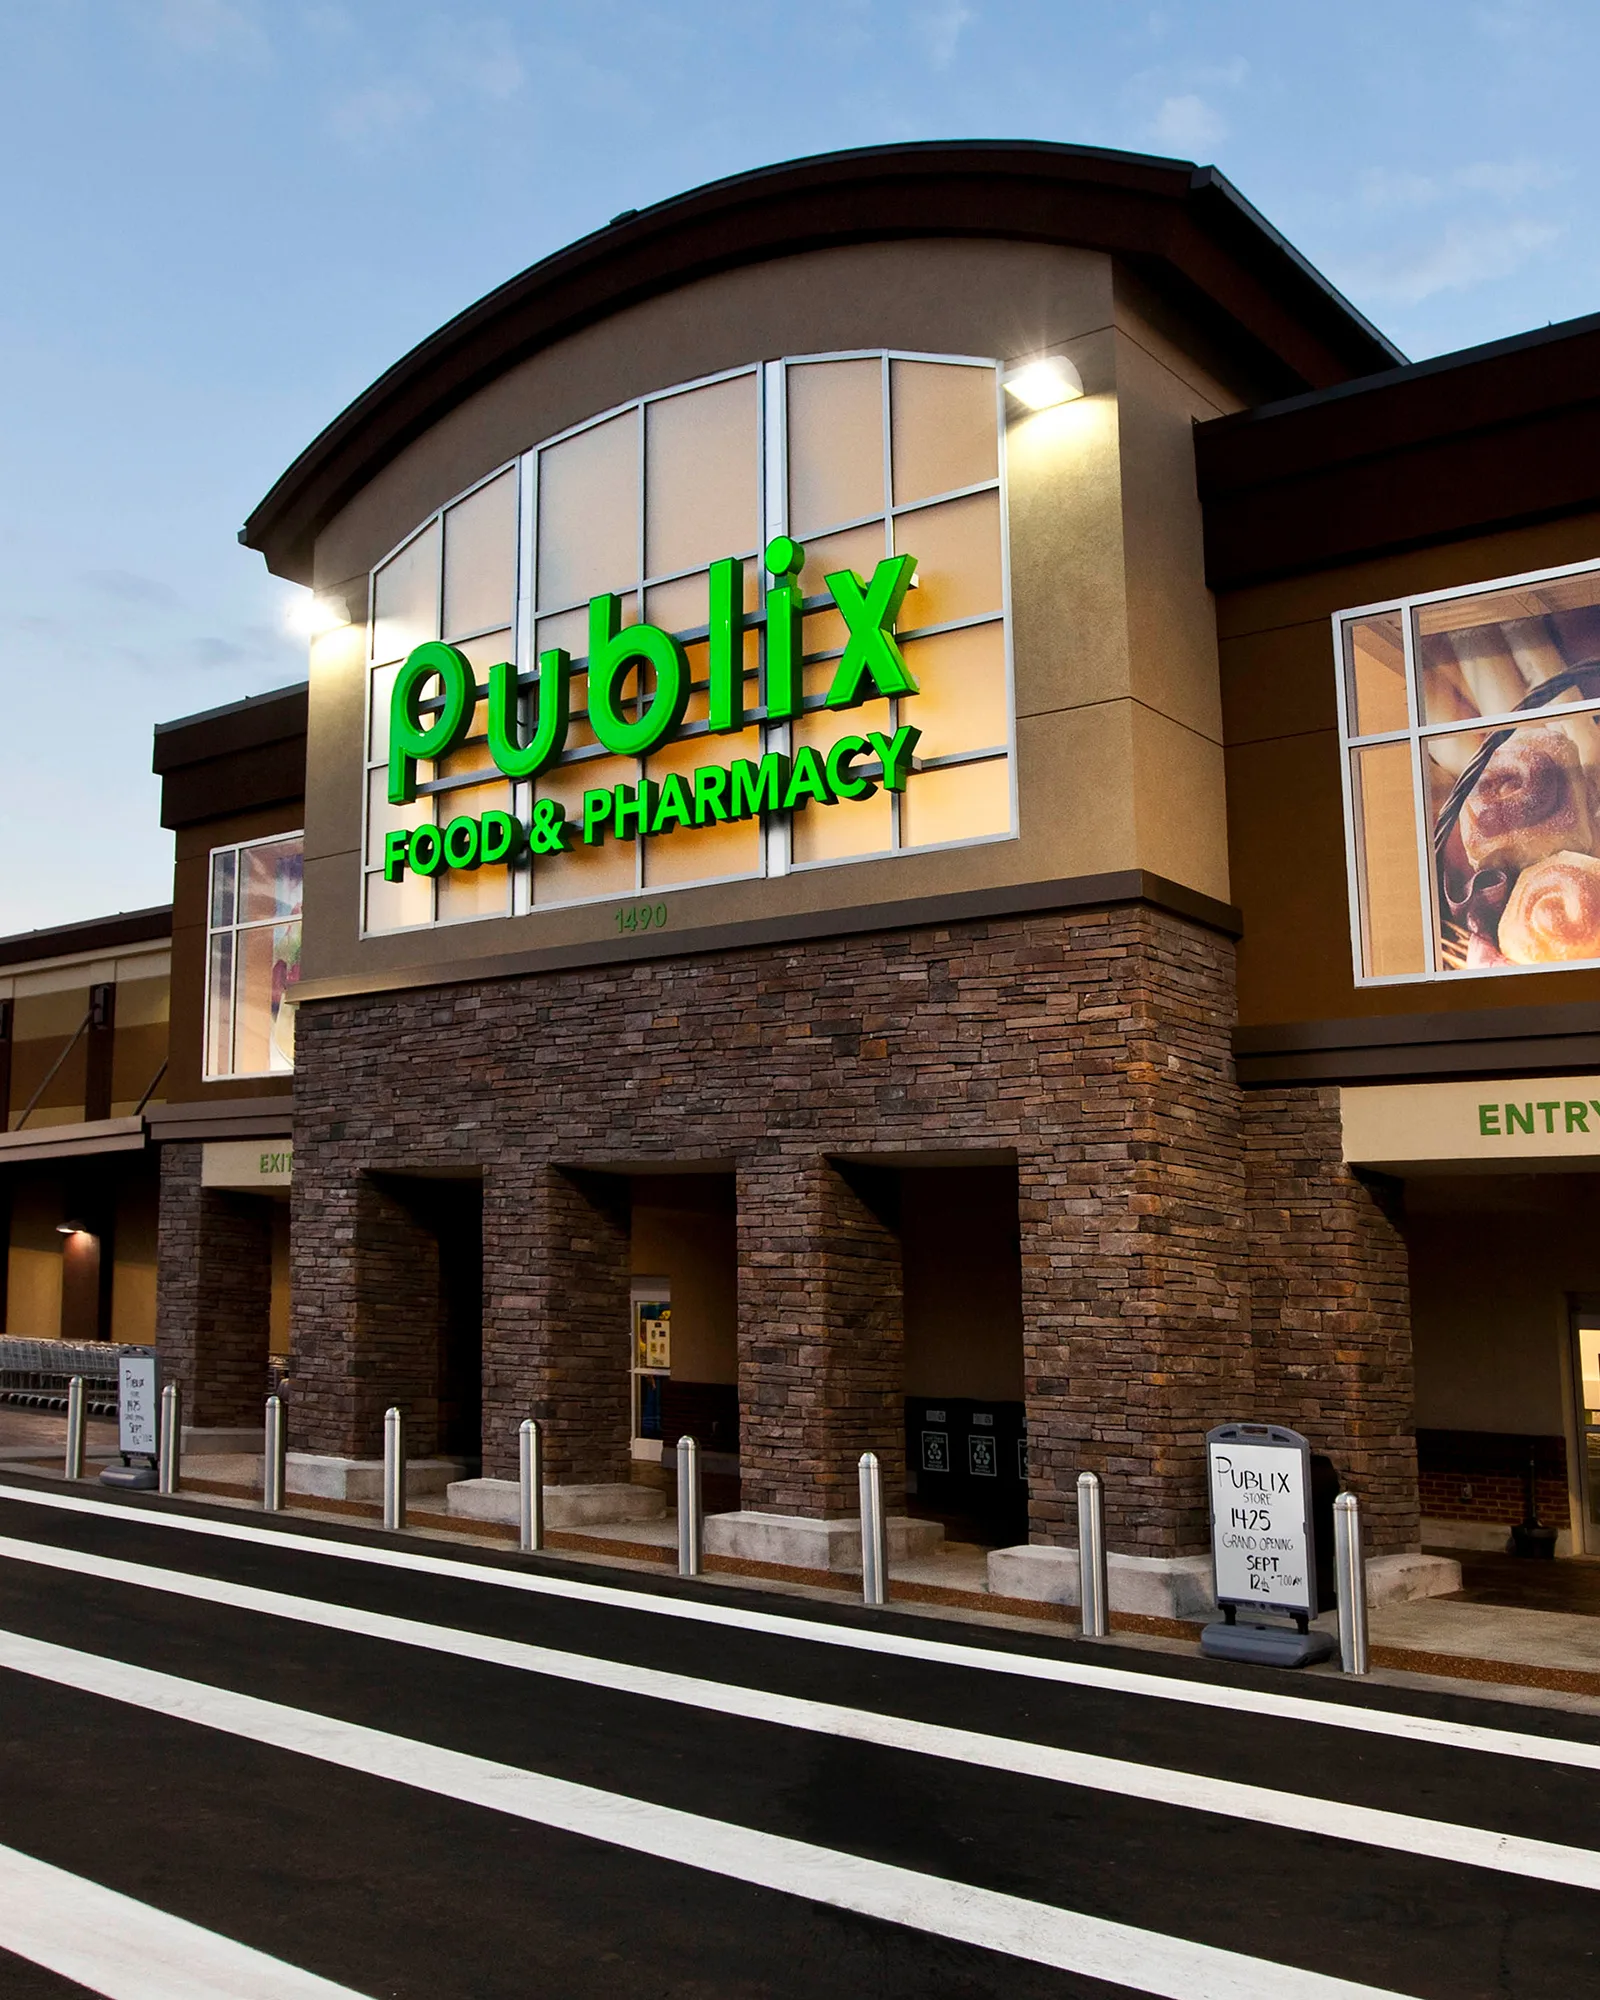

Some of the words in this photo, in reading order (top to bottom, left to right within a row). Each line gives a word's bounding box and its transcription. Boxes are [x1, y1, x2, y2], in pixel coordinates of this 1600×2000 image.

[384, 810, 523, 883] FOOD
[529, 798, 571, 855] &
[583, 725, 922, 846] PHARMACY
[615, 902, 668, 934] 1490
[1215, 1456, 1290, 1493] PUBLIX
[1242, 1492, 1273, 1506] STORE
[1231, 1507, 1271, 1531] 1425
[1222, 1532, 1257, 1550] GRAND
[1259, 1537, 1294, 1551] OPENING
[1246, 1555, 1280, 1572] SEPT
